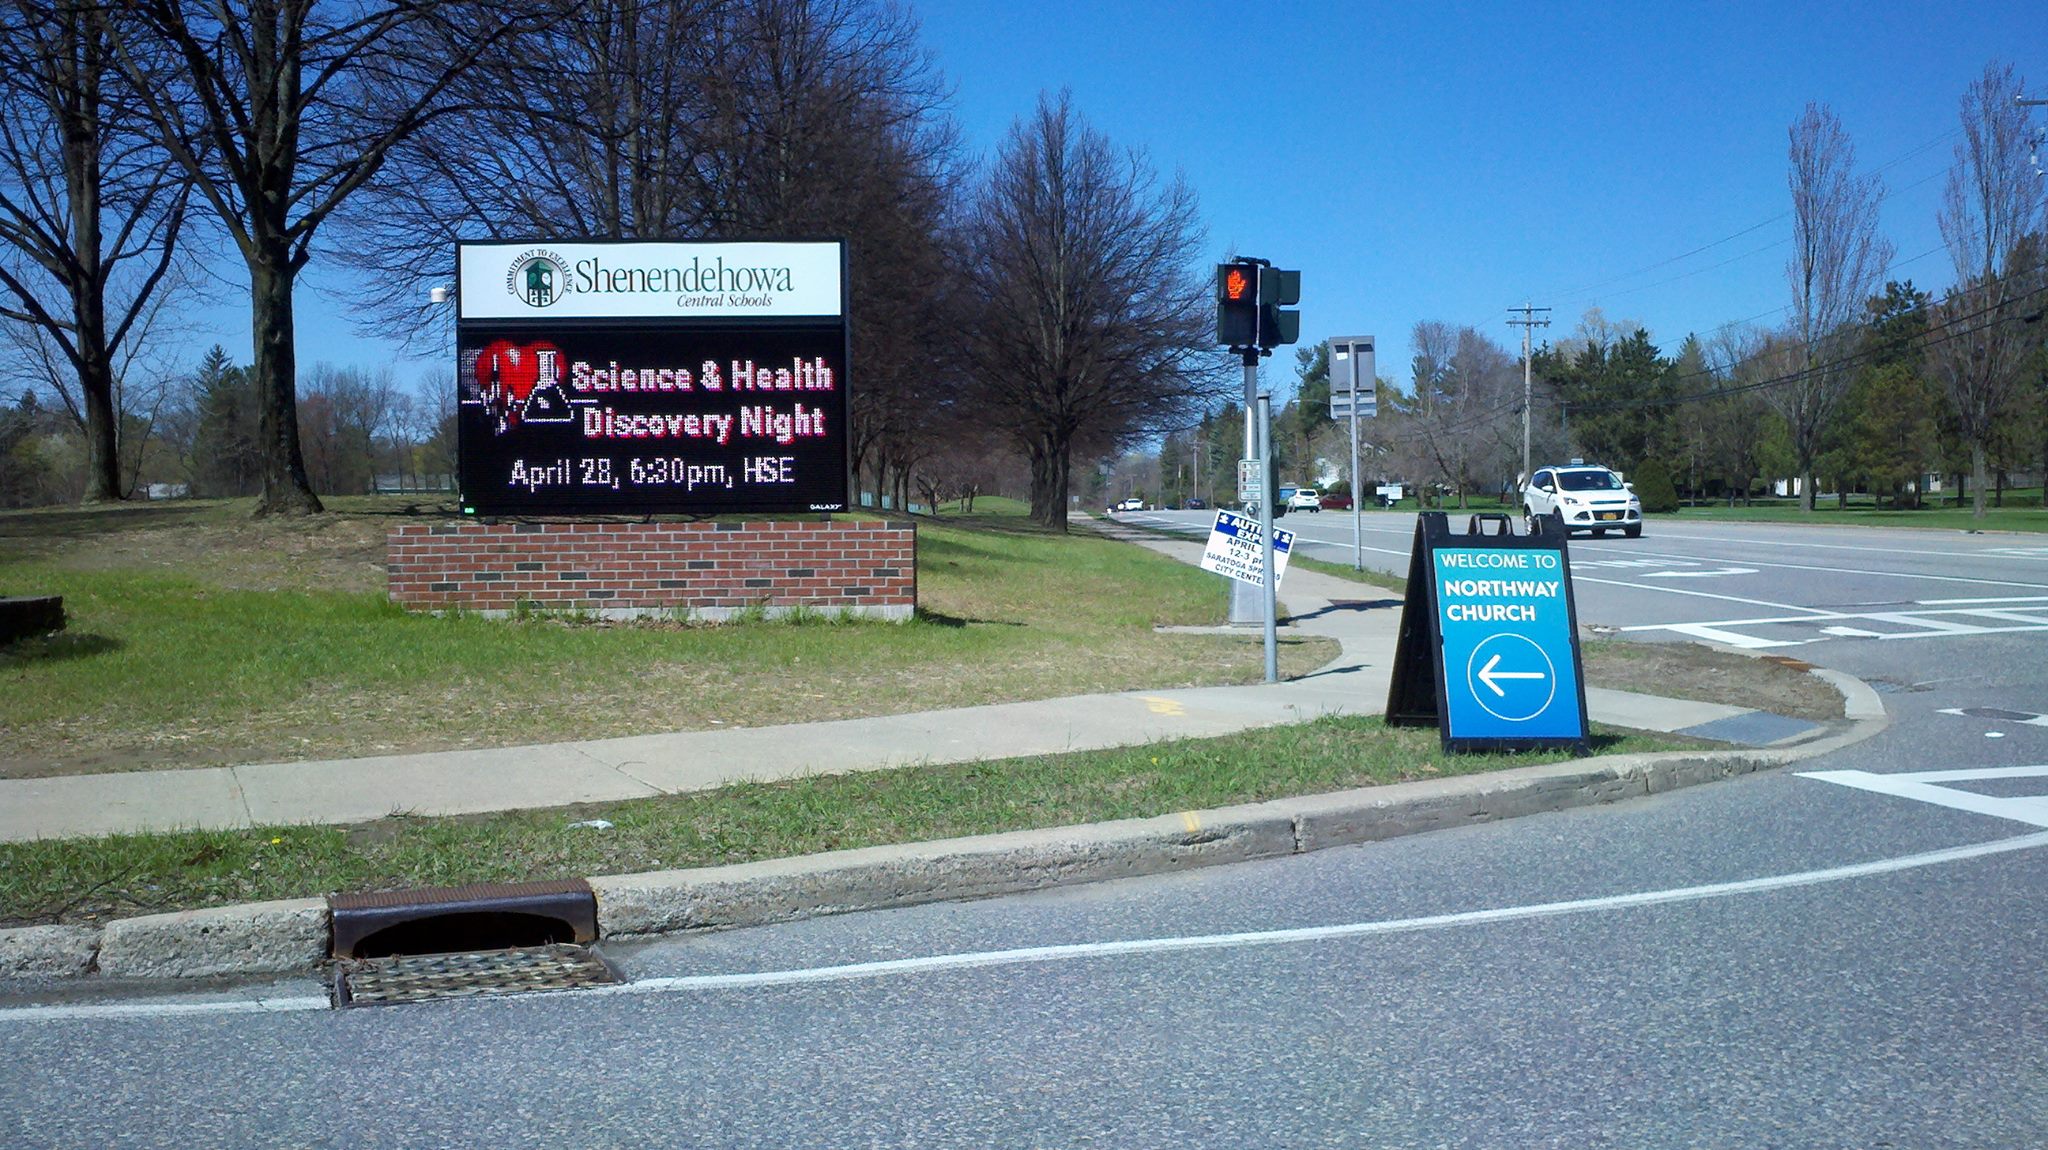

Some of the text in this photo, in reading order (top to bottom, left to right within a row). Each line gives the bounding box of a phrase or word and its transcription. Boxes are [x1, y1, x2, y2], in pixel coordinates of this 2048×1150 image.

[506, 249, 535, 295] COMMITMENT
[536, 249, 548, 257] TO
[575, 256, 795, 294] Shenendehowa
[677, 293, 773, 307] Central Schools
[571, 356, 834, 391] Science & Health
[583, 403, 827, 445] Discovery Night
[508, 456, 795, 493] April 28, 6:30pm, HSE
[1230, 517, 1280, 540] AUTIM
[1226, 537, 1257, 554] APRIL
[1230, 548, 1250, 561] 12-3
[1206, 552, 1246, 570] SARATOGA
[1440, 553, 1528, 569] WELCOME
[1533, 554, 1556, 568] TO
[1215, 564, 1264, 585] CITY CENTE
[1444, 579, 1559, 598] NORTHWAY
[1446, 604, 1536, 622] CHURCH
